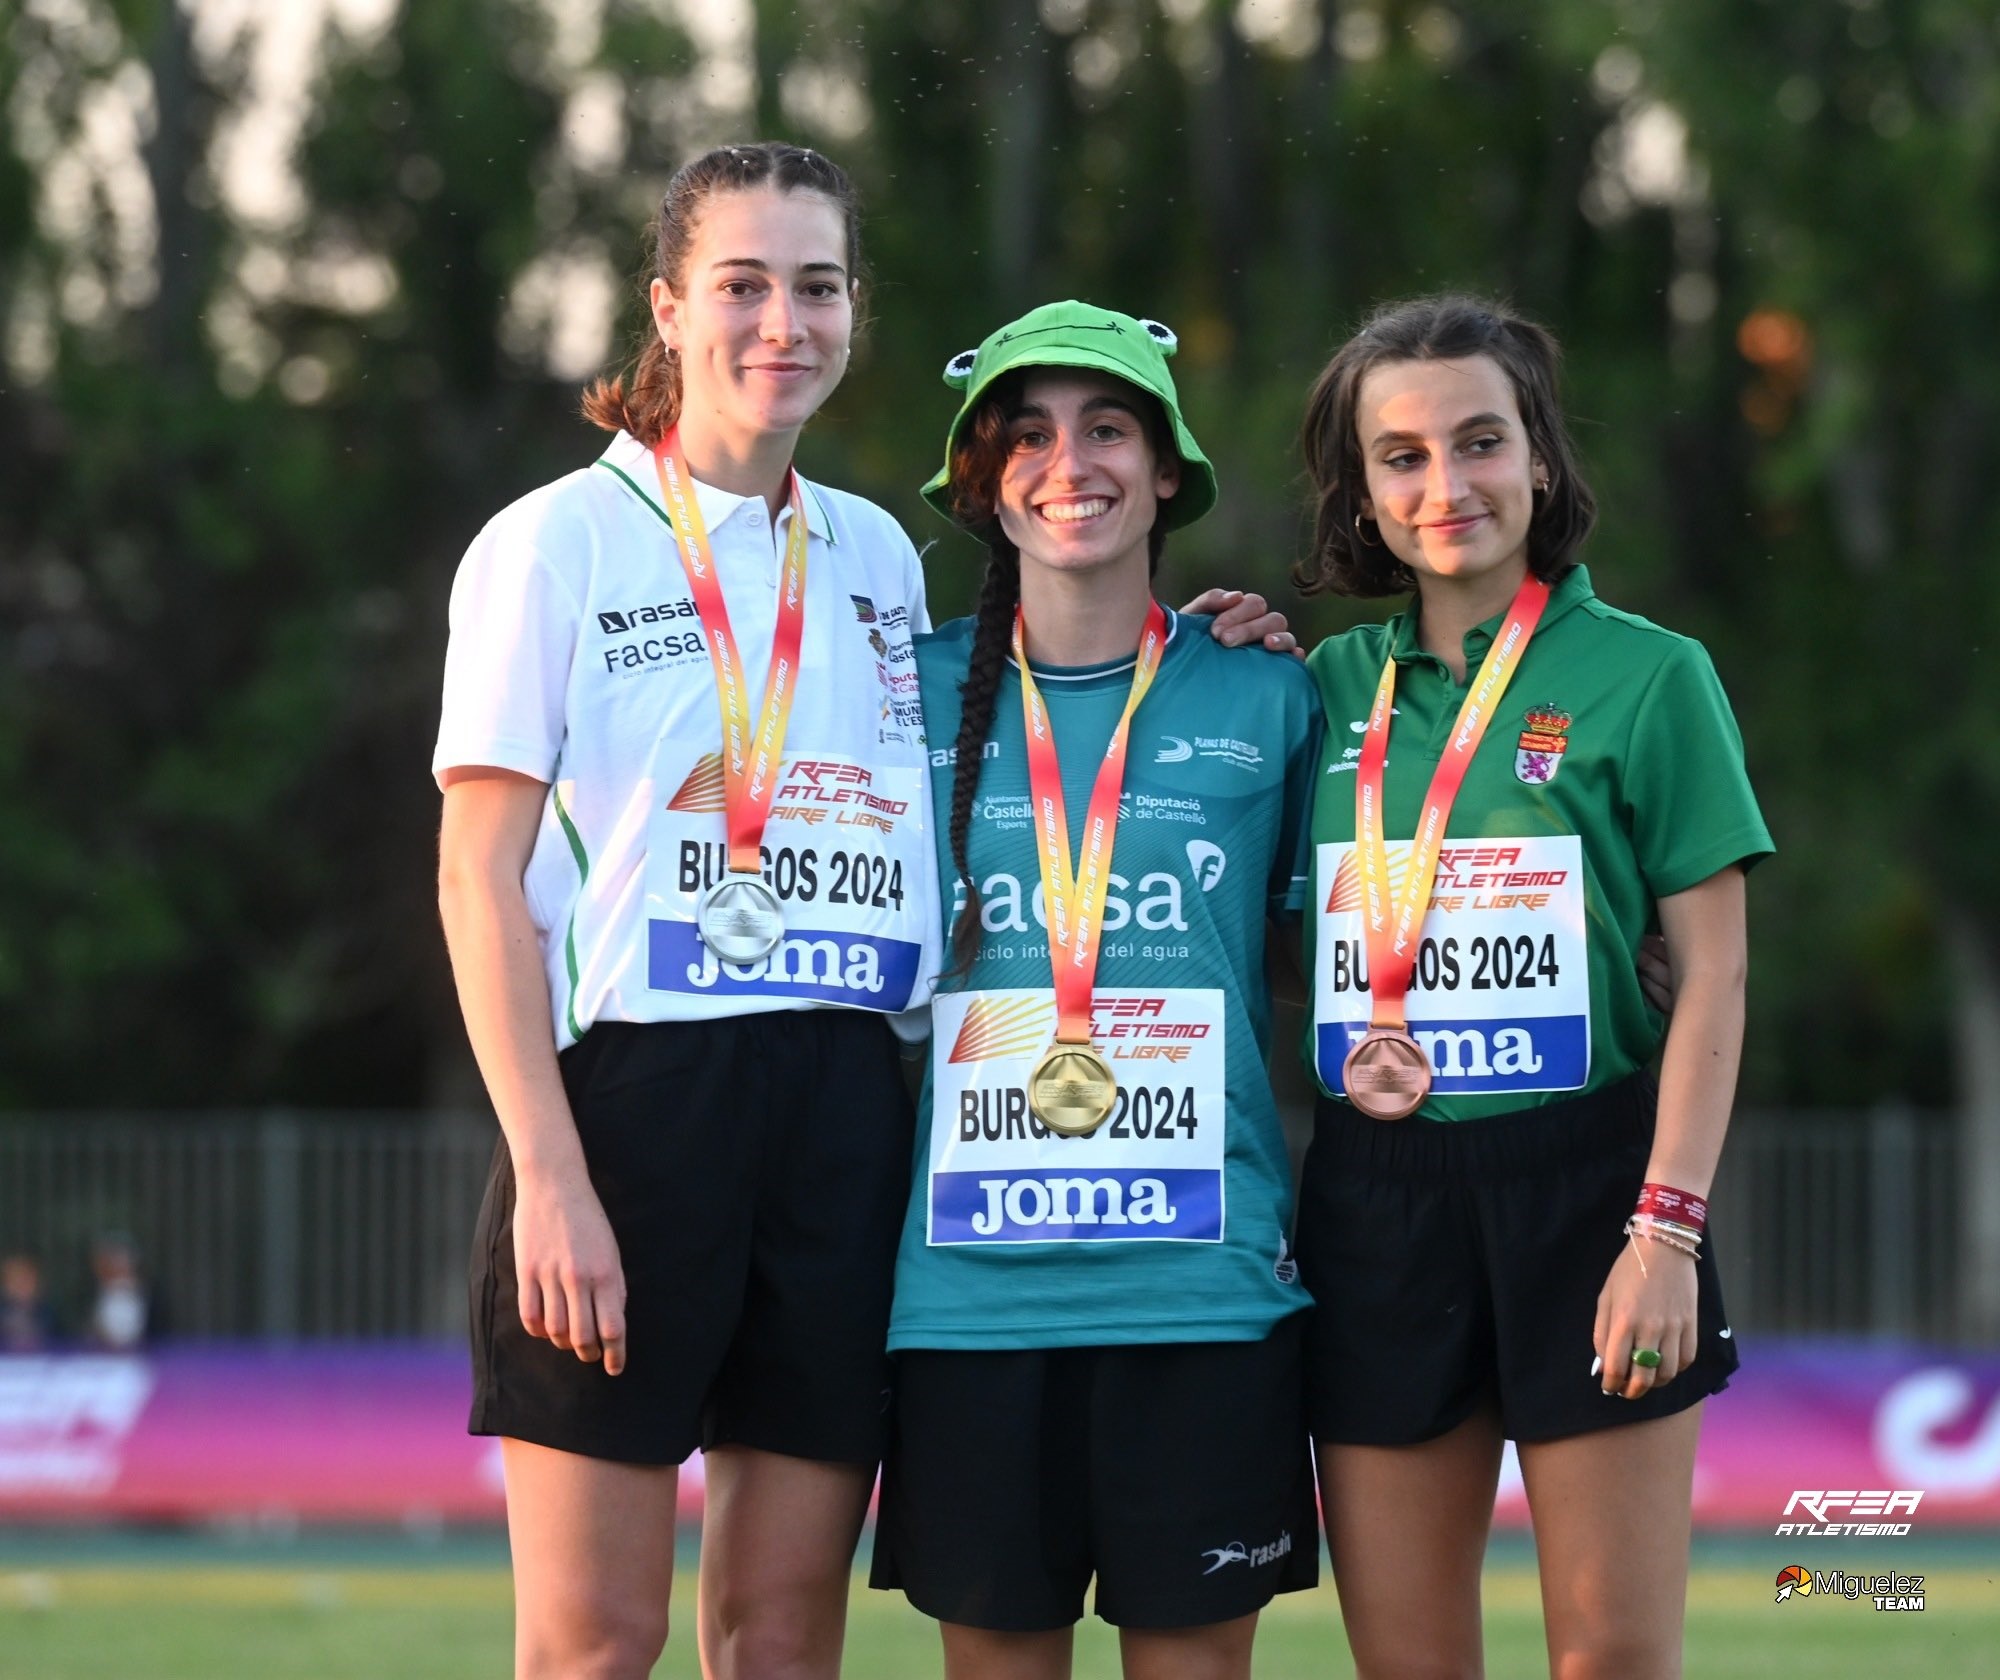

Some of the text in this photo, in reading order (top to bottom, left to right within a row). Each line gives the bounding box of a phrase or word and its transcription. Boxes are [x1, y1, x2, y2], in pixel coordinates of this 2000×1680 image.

[604, 632, 706, 673] Facsa
[1455, 622, 1522, 752] RFEA ATLETISMO
[1220, 738, 1230, 749] DE
[787, 761, 872, 787] RFEA
[777, 785, 909, 816] ATLETISMO
[984, 795, 1031, 806] Ajuntament
[984, 803, 1036, 819] Castell
[1136, 794, 1200, 811] Diputació
[767, 806, 894, 836] AIRE LIBRE
[996, 820, 1028, 830] Esports
[1135, 808, 1207, 825] de Castelló
[1363, 783, 1384, 932] RFEA ATLETISMO
[828, 850, 904, 911] 2024
[1042, 797, 1070, 948] RFEA ATLETISMO
[1393, 805, 1440, 957] RFEA ATLETISMO
[1073, 816, 1105, 968] RFEA ATLETISMO
[1472, 893, 1551, 911] LIBRE
[1105, 943, 1133, 958] del
[1142, 945, 1189, 961] agua
[1334, 933, 1560, 993] BUOS 2024
[1088, 999, 1166, 1021] FEA
[1112, 1046, 1192, 1063] LIBRE
[1109, 1086, 1198, 1139] 2024
